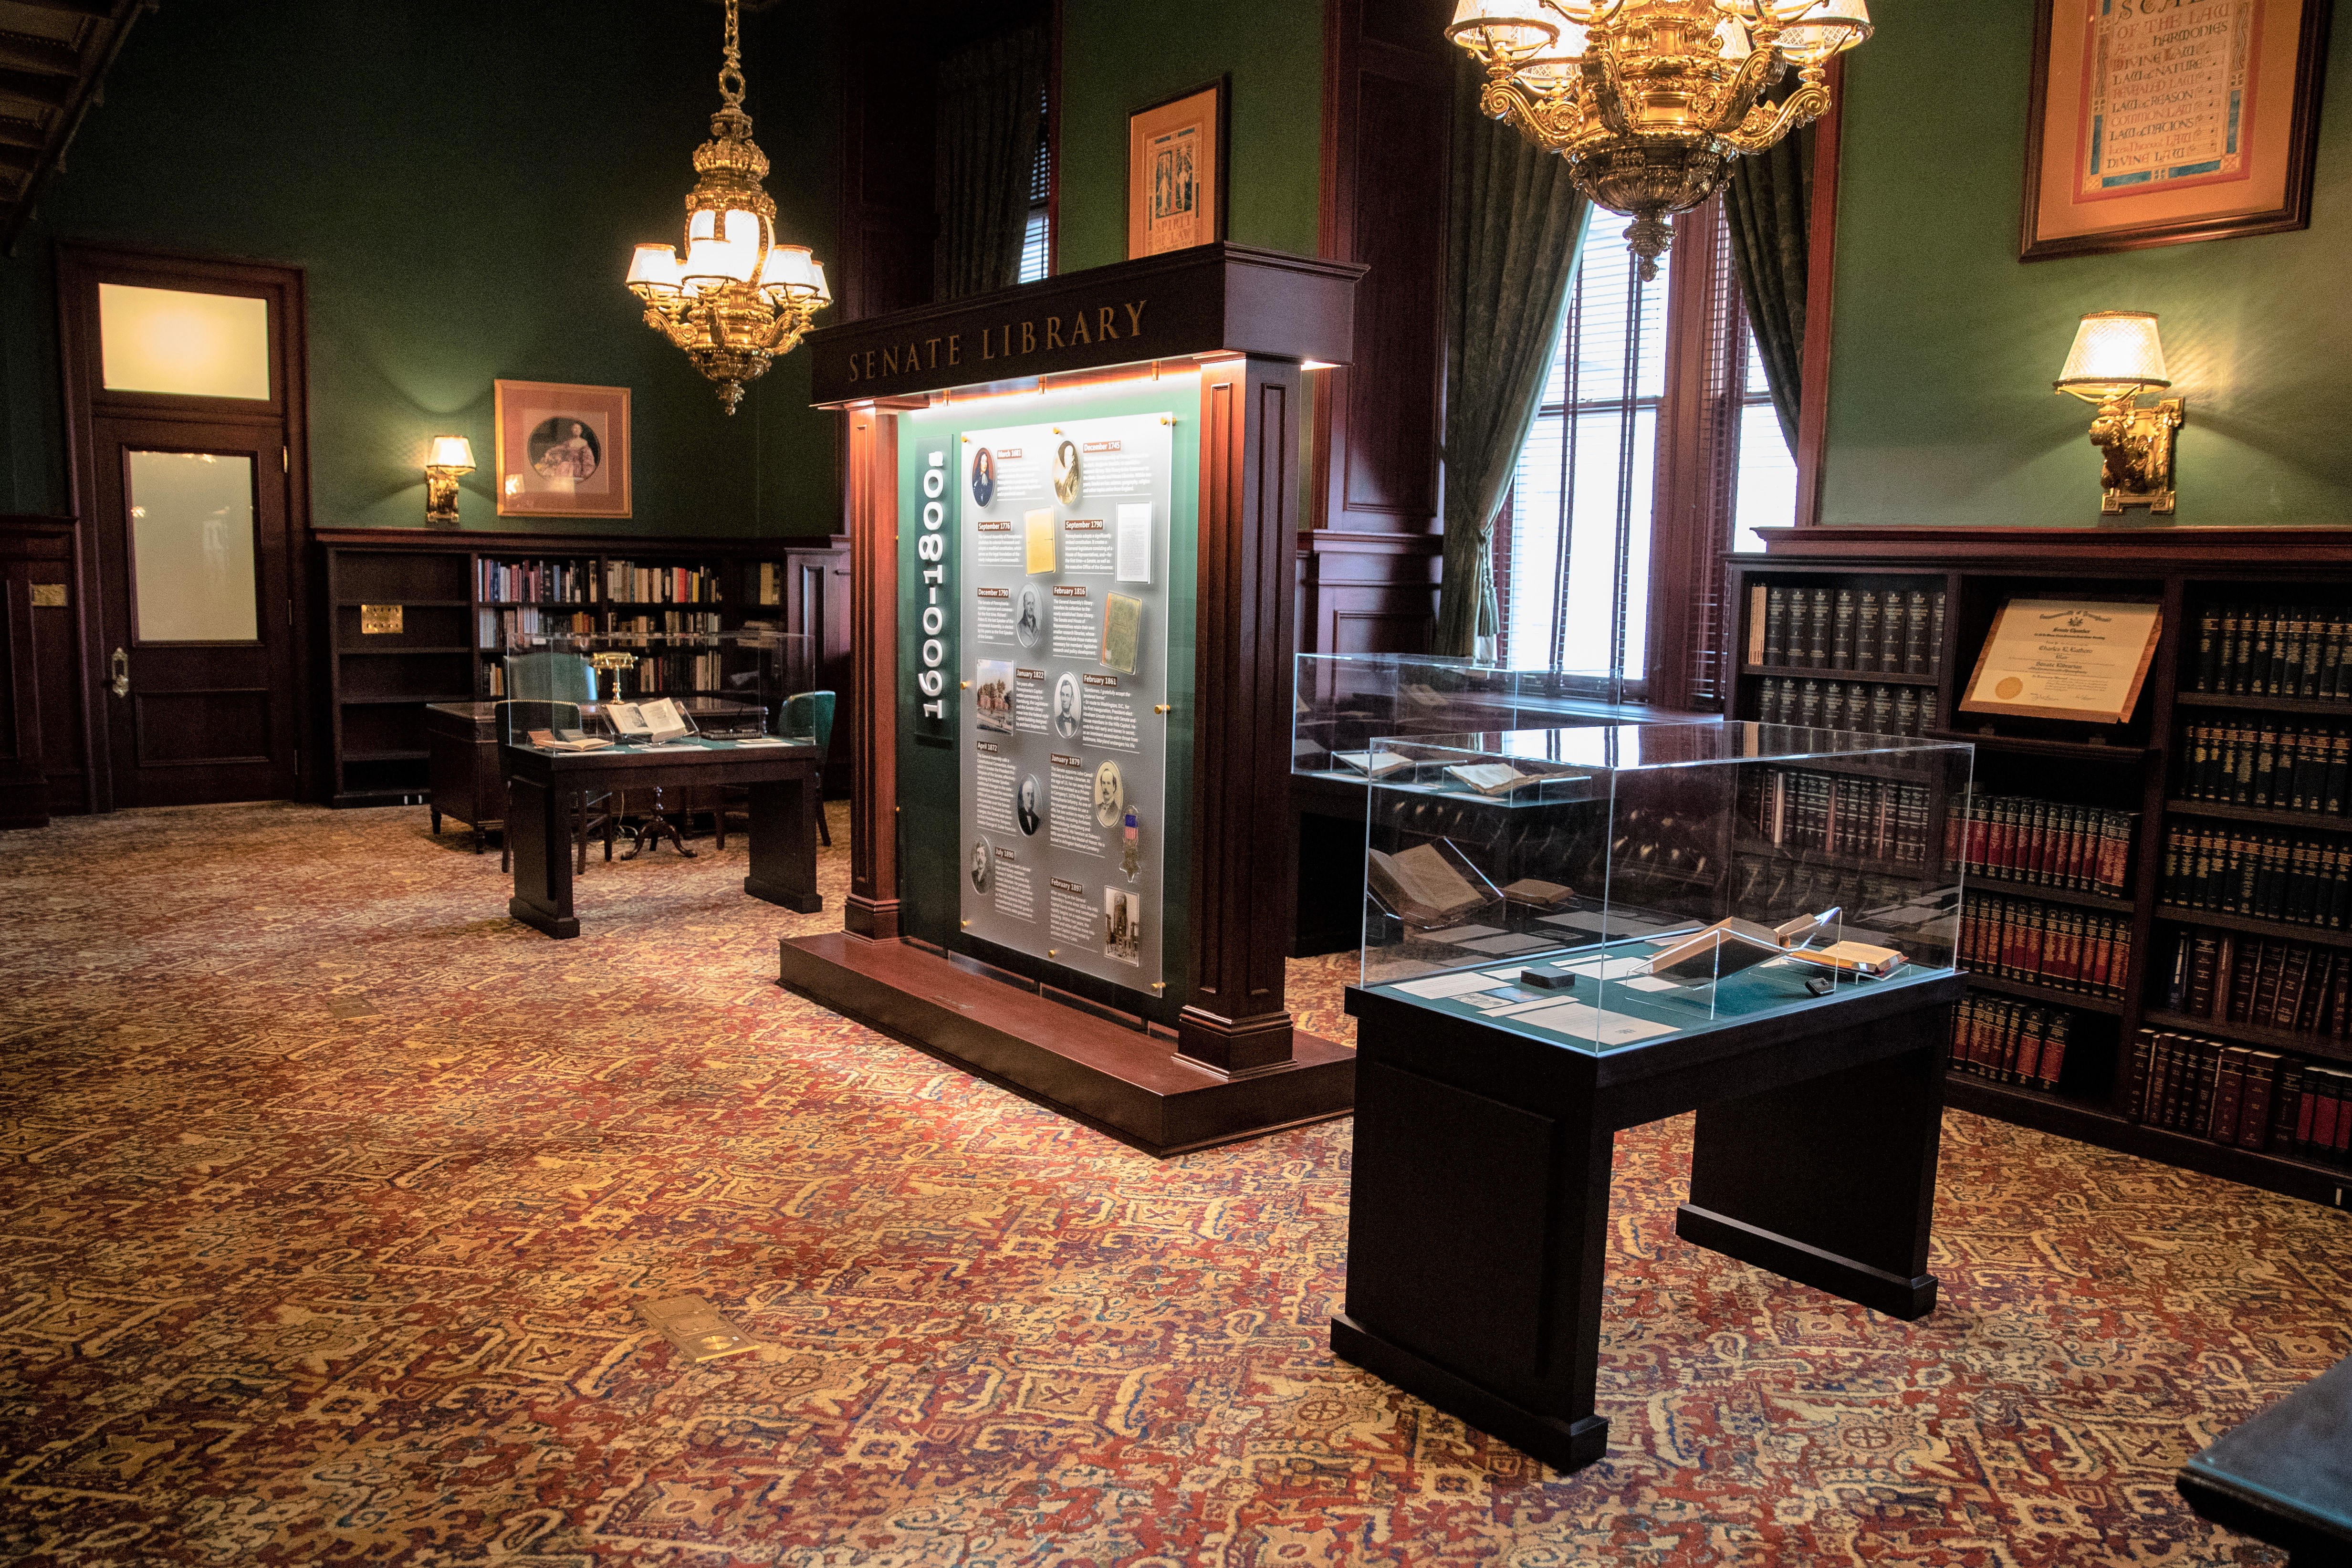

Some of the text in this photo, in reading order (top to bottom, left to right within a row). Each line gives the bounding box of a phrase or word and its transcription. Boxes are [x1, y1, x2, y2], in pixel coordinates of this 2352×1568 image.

[2117, 22, 2139, 39] OF
[2145, 13, 2182, 33] THE
[2189, 3, 2229, 24] LAW
[2113, 71, 2143, 85] LAW
[2154, 58, 2206, 76] NATURE
[2112, 99, 2139, 113] LAW
[2150, 89, 2194, 106] REASON
[2110, 128, 2135, 141] LAW
[2166, 132, 2192, 147] LAW
[2107, 147, 2185, 168] DIVINE LAW
[1155, 215, 1192, 234] SPIRIT
[849, 300, 1147, 382] SENATE LIBRARY
[1084, 443, 1107, 451] December
[979, 523, 999, 531] September
[1066, 521, 1089, 530] September
[919, 450, 943, 719] 1600-1800s
[1054, 587, 1073, 596] February
[1016, 669, 1033, 679] January
[1084, 675, 1104, 685] February
[977, 742, 987, 751] April
[1051, 754, 1080, 765] January 1879
[995, 847, 1014, 859] July 1890
[1051, 878, 1082, 892] February 1897
